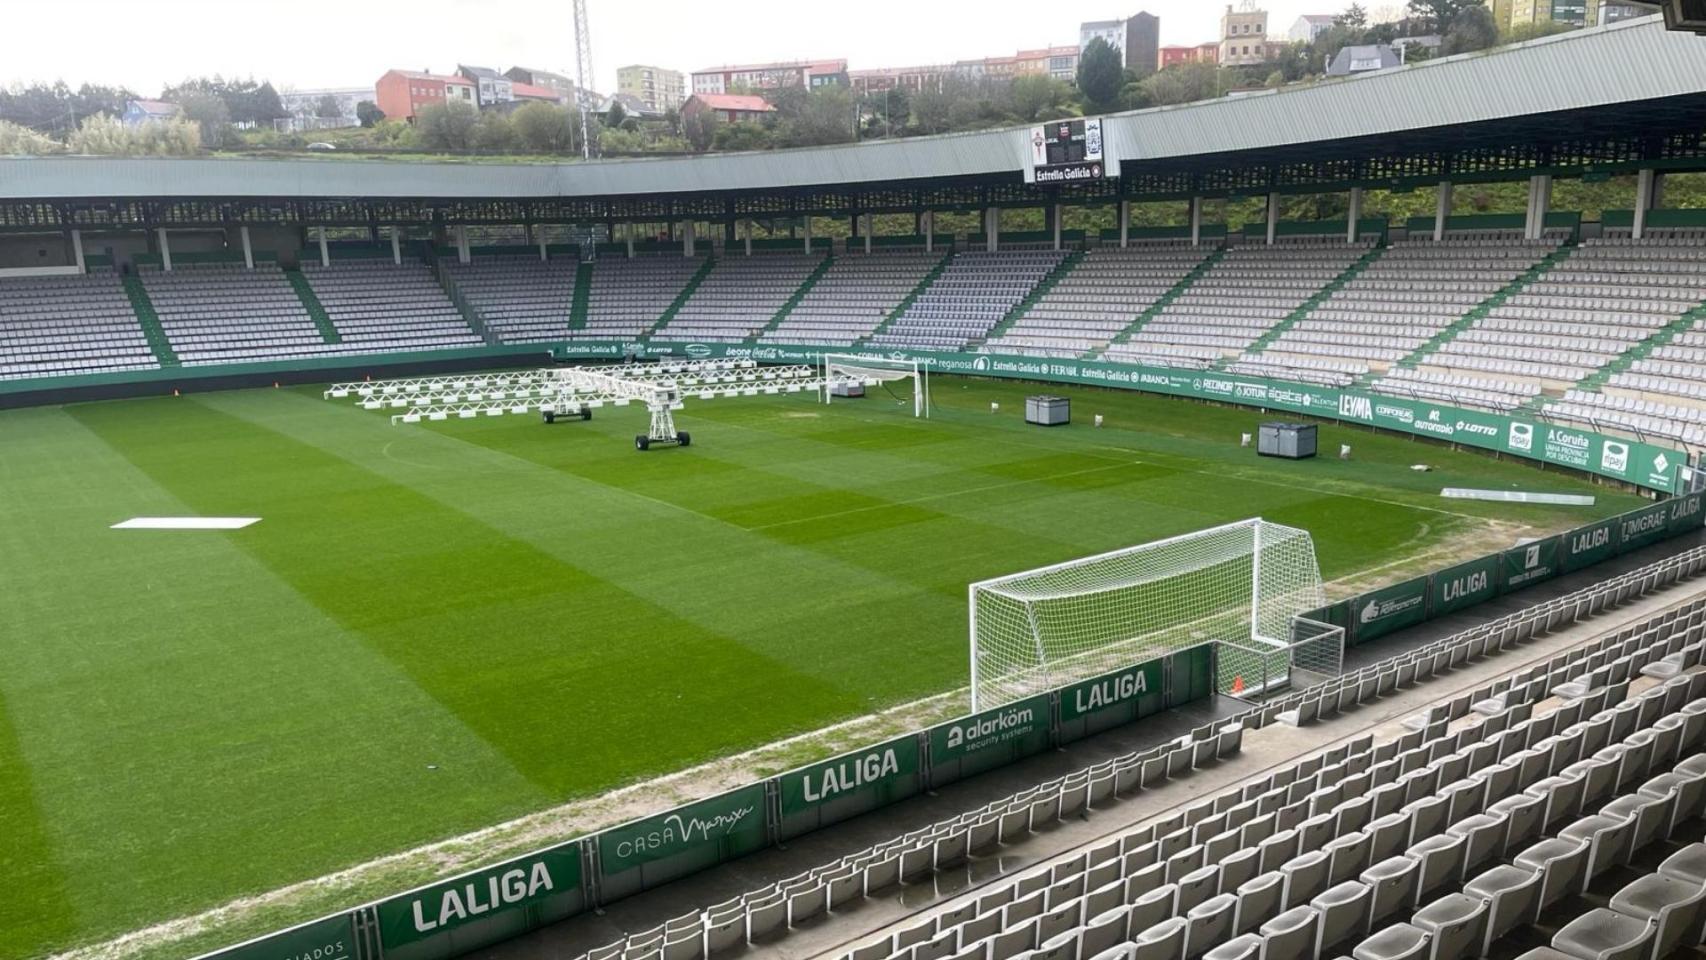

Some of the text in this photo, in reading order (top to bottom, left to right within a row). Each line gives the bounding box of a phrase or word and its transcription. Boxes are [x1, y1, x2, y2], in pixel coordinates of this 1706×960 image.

[1037, 167, 1091, 181] Estrella Galicia
[591, 345, 610, 353] Galicia
[938, 360, 973, 371] reganosa
[993, 361, 1040, 374] Estrella Galicia
[1081, 367, 1130, 382] Estrella Galicia
[1140, 374, 1169, 385] ABANCA
[1243, 386, 1266, 398] JOTUN
[1339, 393, 1373, 420] LEYMA
[1465, 423, 1498, 436] LOTTO
[1547, 429, 1589, 447] A Coruña
[1545, 450, 1557, 459] POR
[1560, 446, 1590, 459] PROVINCIA
[1671, 497, 1700, 520] LALIGA
[1572, 527, 1609, 554] LALIGA
[1443, 570, 1487, 602] LALIGA
[1076, 670, 1147, 713] LALIGA
[966, 706, 1033, 741] alarköm
[966, 724, 1033, 751] security systems
[803, 748, 899, 803] LALIGA
[617, 827, 674, 858] CASA
[412, 861, 554, 933] LALIGA
[285, 941, 344, 960] ADOS
